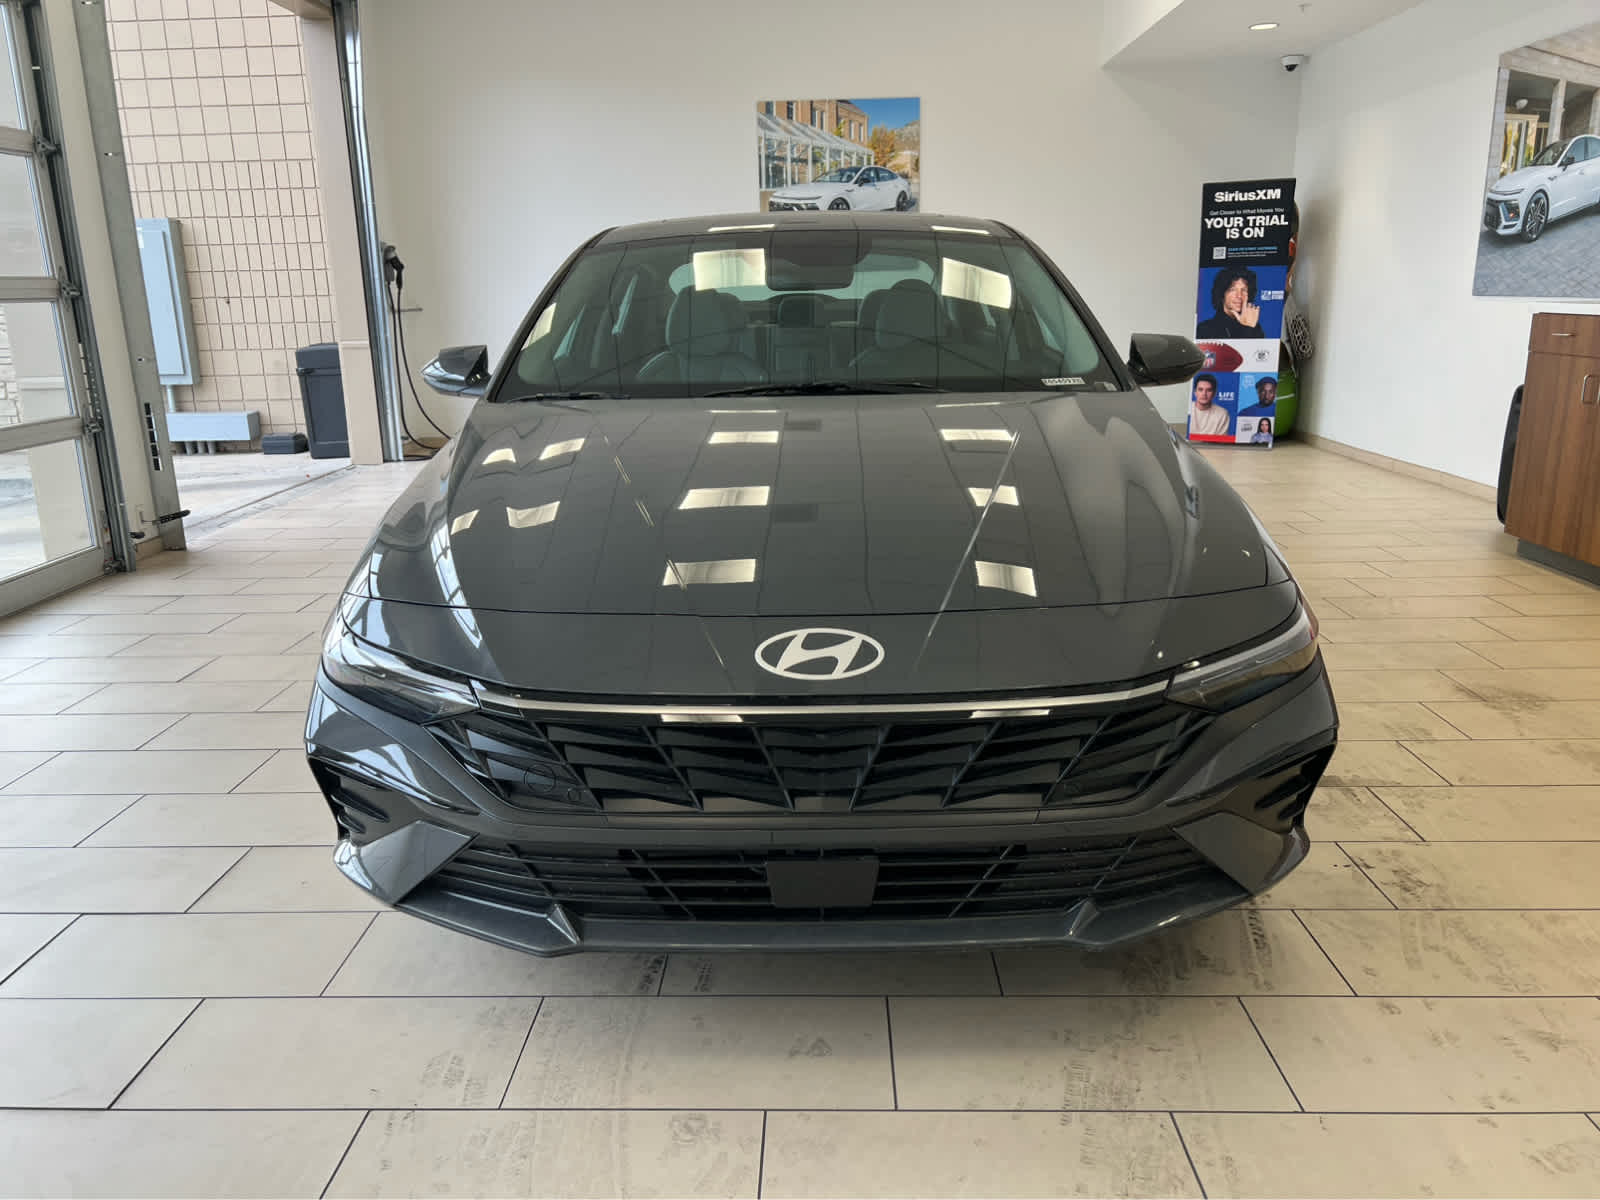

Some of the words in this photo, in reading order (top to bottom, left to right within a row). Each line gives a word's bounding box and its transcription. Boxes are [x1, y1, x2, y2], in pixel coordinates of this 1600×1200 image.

[1214, 188, 1281, 202] SiriusXM
[1204, 216, 1244, 229] YOUR
[1246, 214, 1289, 227] TRIAL
[1225, 228, 1240, 239] IS
[1242, 226, 1264, 239] ON
